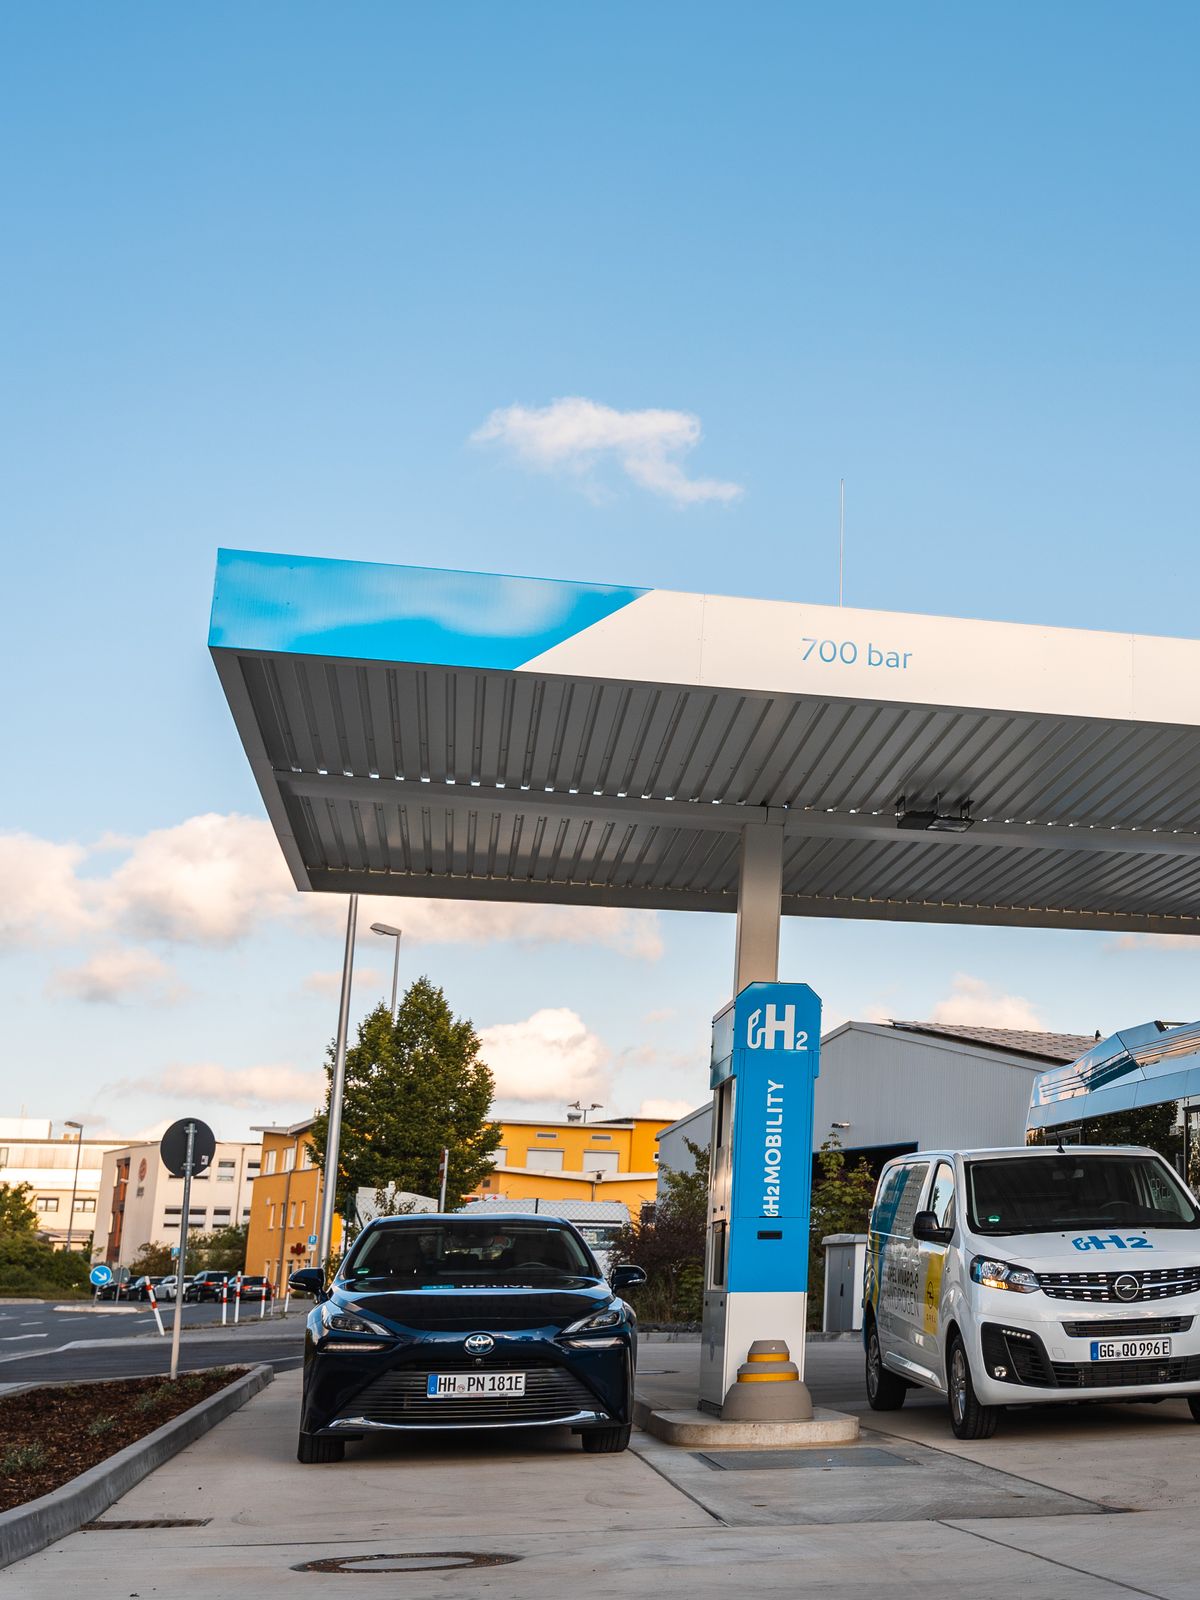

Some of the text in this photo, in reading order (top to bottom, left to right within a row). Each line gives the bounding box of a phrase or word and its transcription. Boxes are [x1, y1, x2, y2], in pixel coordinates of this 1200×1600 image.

[802, 637, 913, 669] 700 bar
[763, 1079, 785, 1212] H2MOBILITY
[1100, 1344, 1115, 1358] GG
[438, 1375, 523, 1393] HH PN 181E
